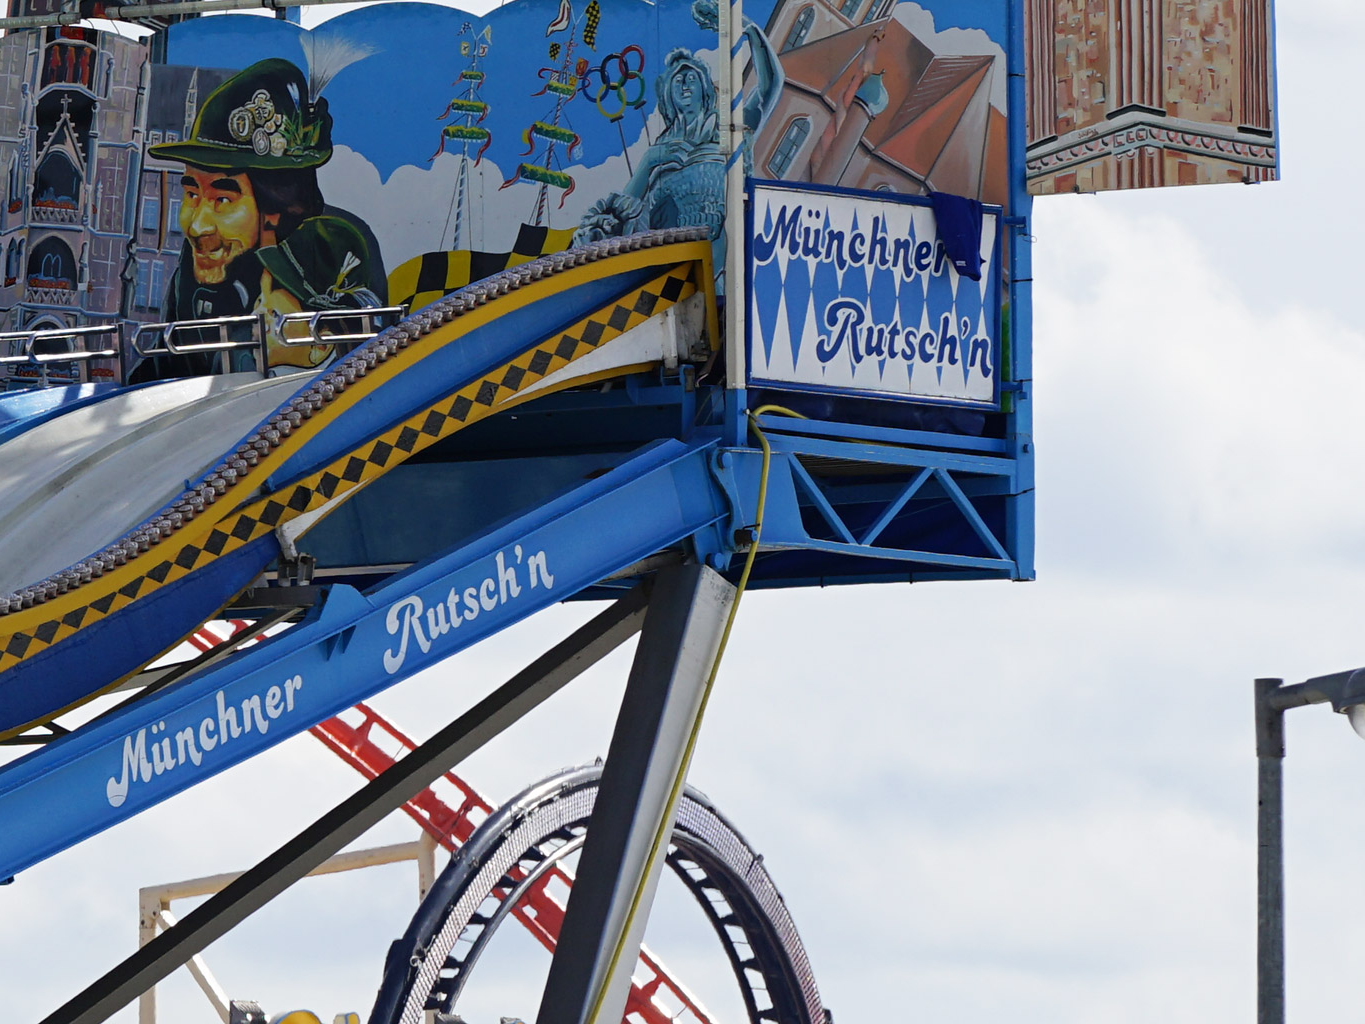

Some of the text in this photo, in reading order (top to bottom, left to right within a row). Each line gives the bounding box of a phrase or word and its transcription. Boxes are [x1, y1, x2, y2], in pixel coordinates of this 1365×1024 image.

[753, 204, 952, 278] Münchner
[817, 300, 992, 379] Rutsch'n
[106, 543, 554, 807] Münchner Rutsch'n
